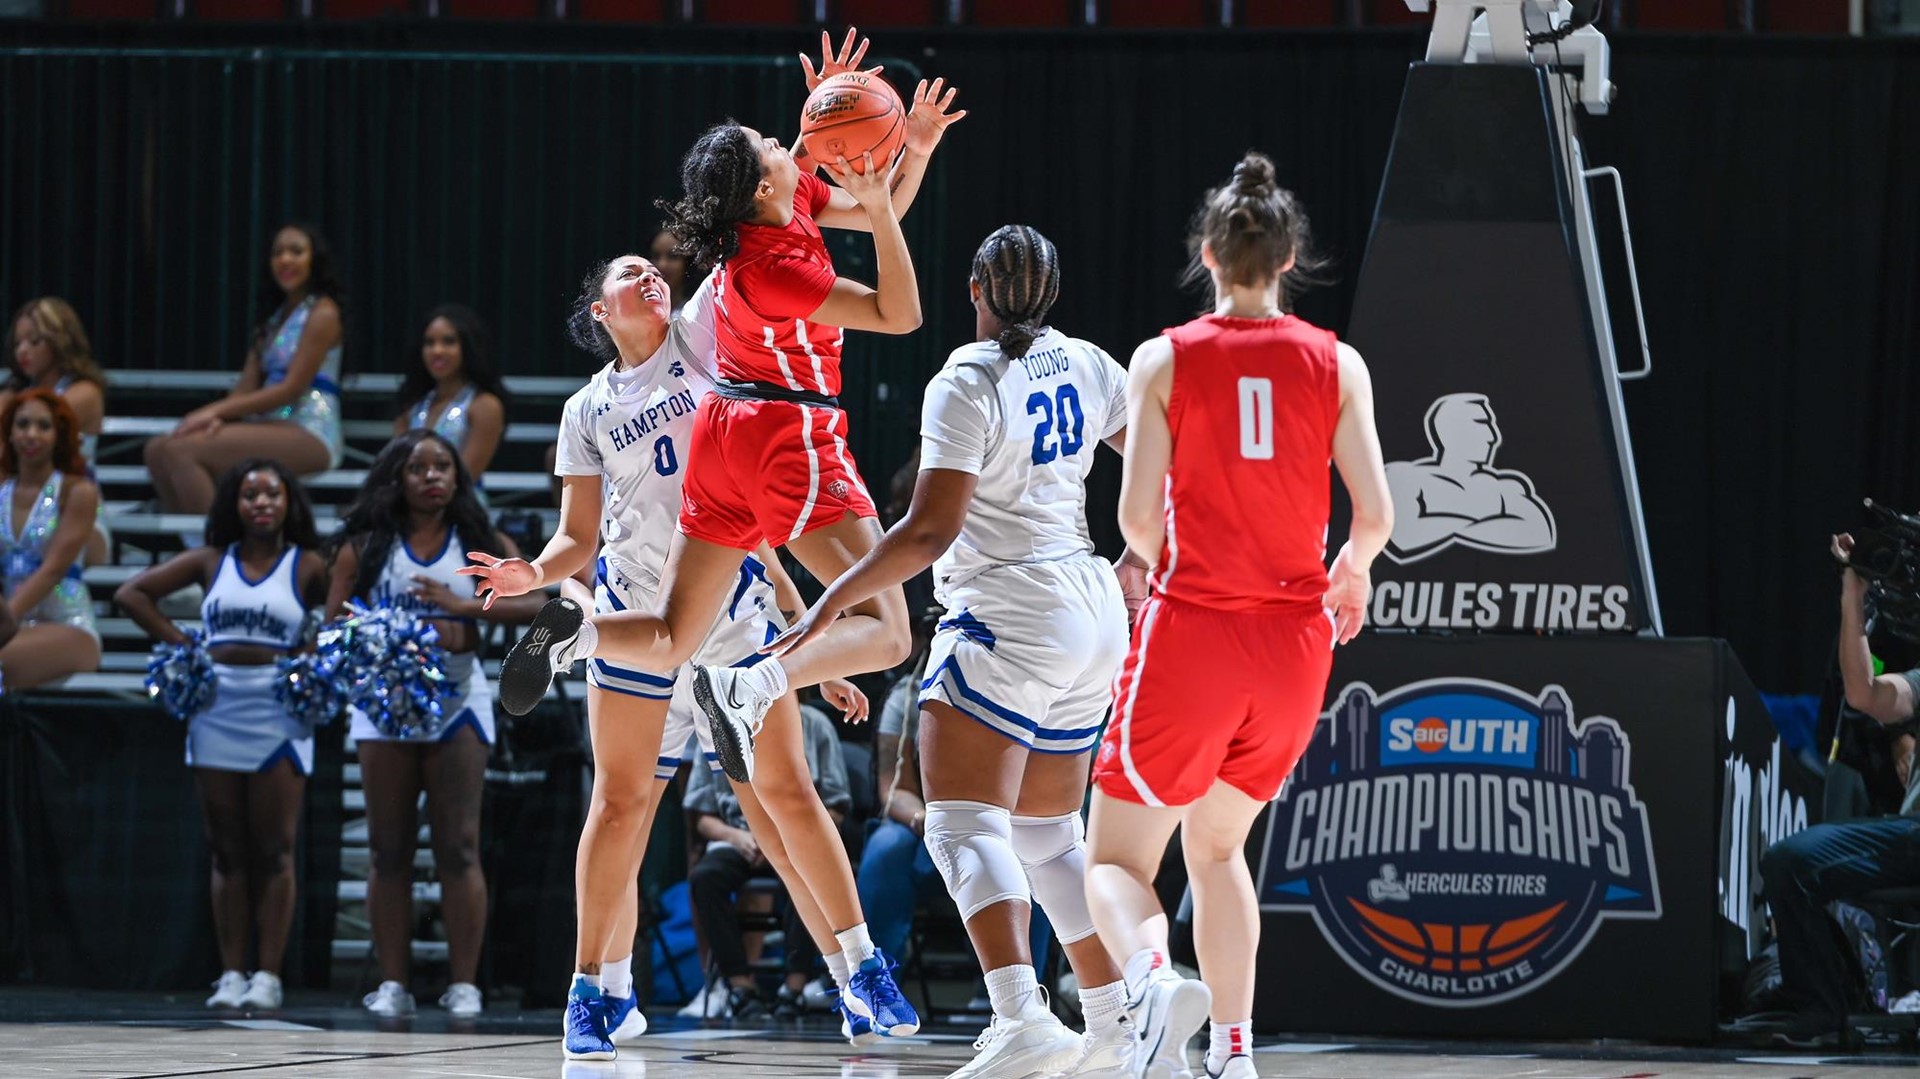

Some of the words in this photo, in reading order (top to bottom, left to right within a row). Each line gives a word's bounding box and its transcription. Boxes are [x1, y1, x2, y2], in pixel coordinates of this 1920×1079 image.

[1019, 347, 1069, 381] YOUNG
[609, 389, 697, 452] HAMPTON
[1026, 383, 1084, 466] 20
[1237, 376, 1274, 460] 0
[653, 434, 679, 477] 0
[206, 597, 288, 642] Hampton
[1510, 583, 1629, 630] TIRES
[1413, 727, 1450, 744] BIG
[1285, 773, 1631, 877] CHAMPIONSHIPS
[1405, 873, 1493, 895] HERCULES
[1495, 874, 1547, 896] TIRES
[1378, 958, 1534, 994] CHARLOTTE
